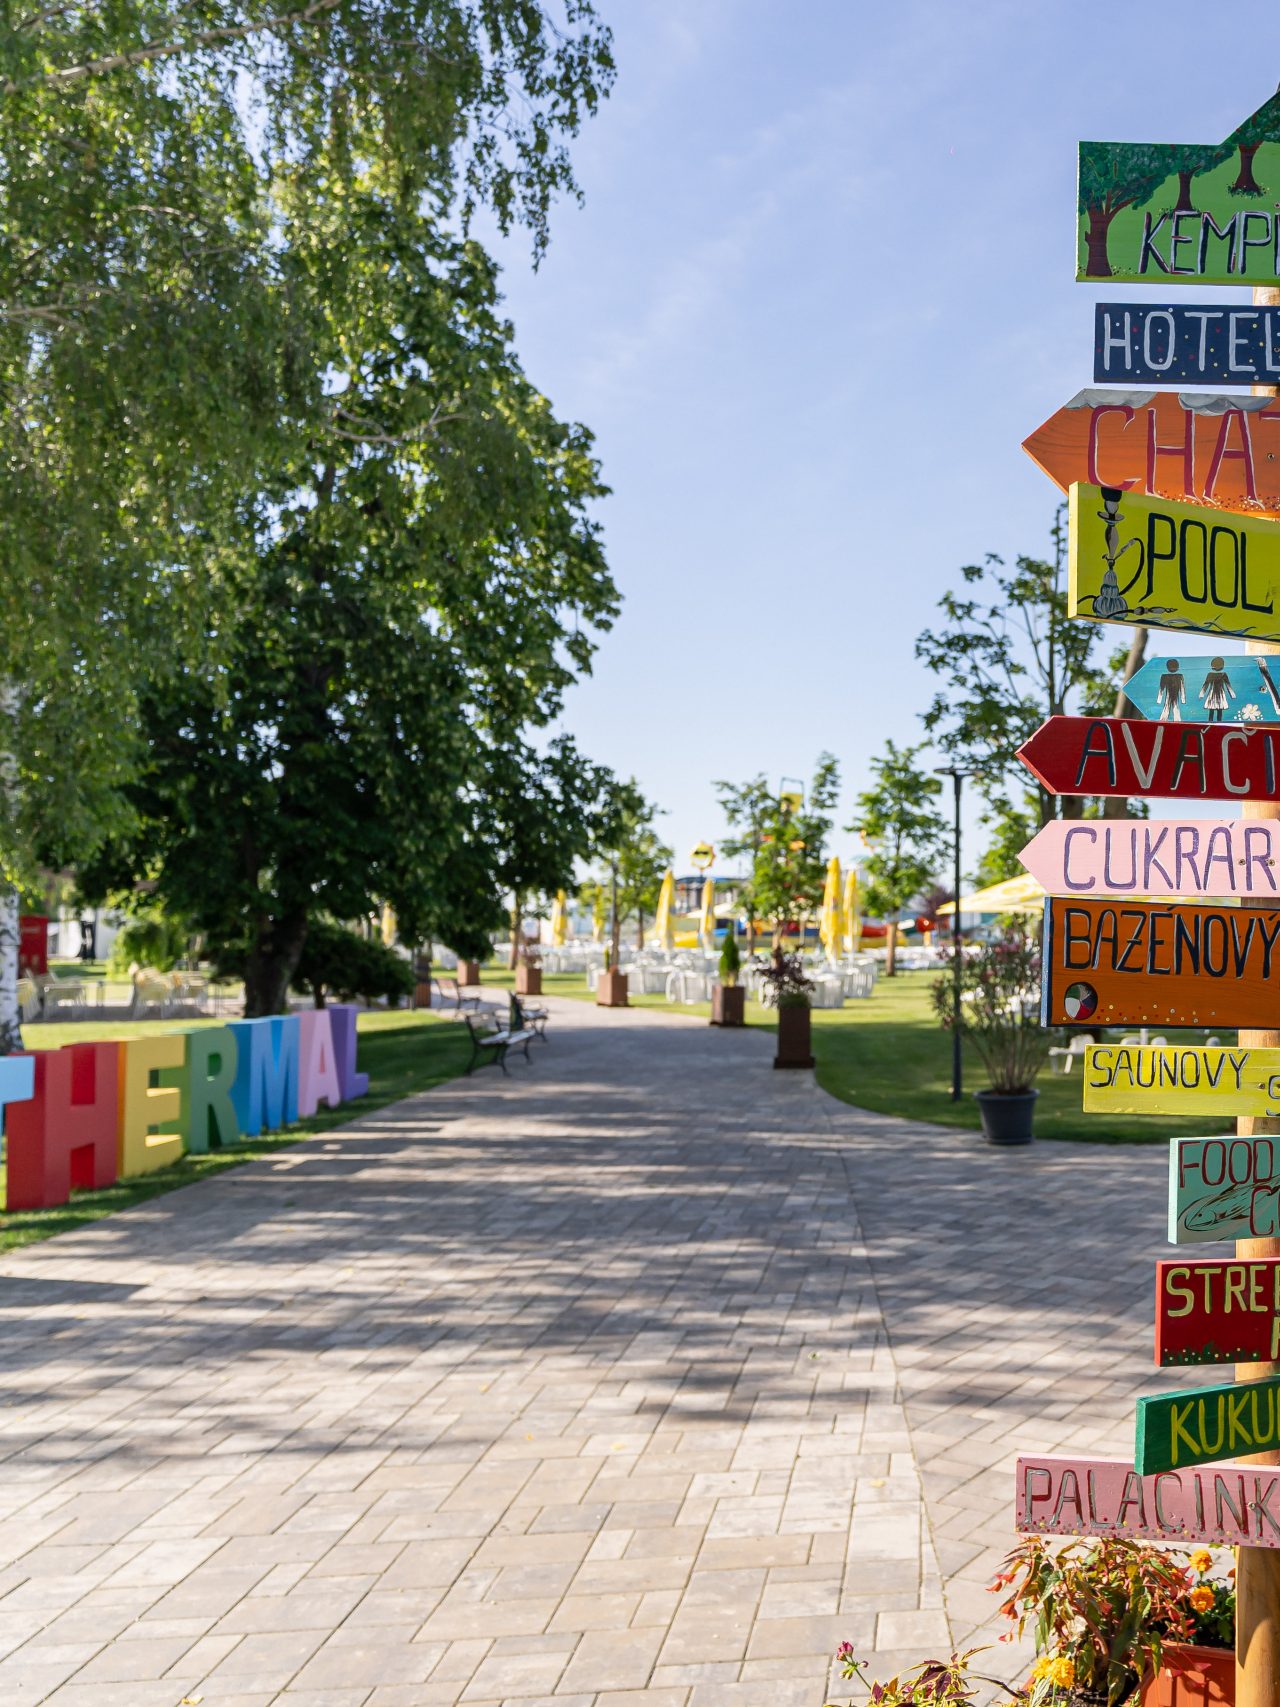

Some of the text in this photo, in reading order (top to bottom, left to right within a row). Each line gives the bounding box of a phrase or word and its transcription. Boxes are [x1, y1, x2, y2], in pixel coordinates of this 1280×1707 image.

[1140, 512, 1274, 614] POOL
[1090, 1048, 1249, 1091] SAUNOVÝ
[1178, 1139, 1274, 1188] FOOD
